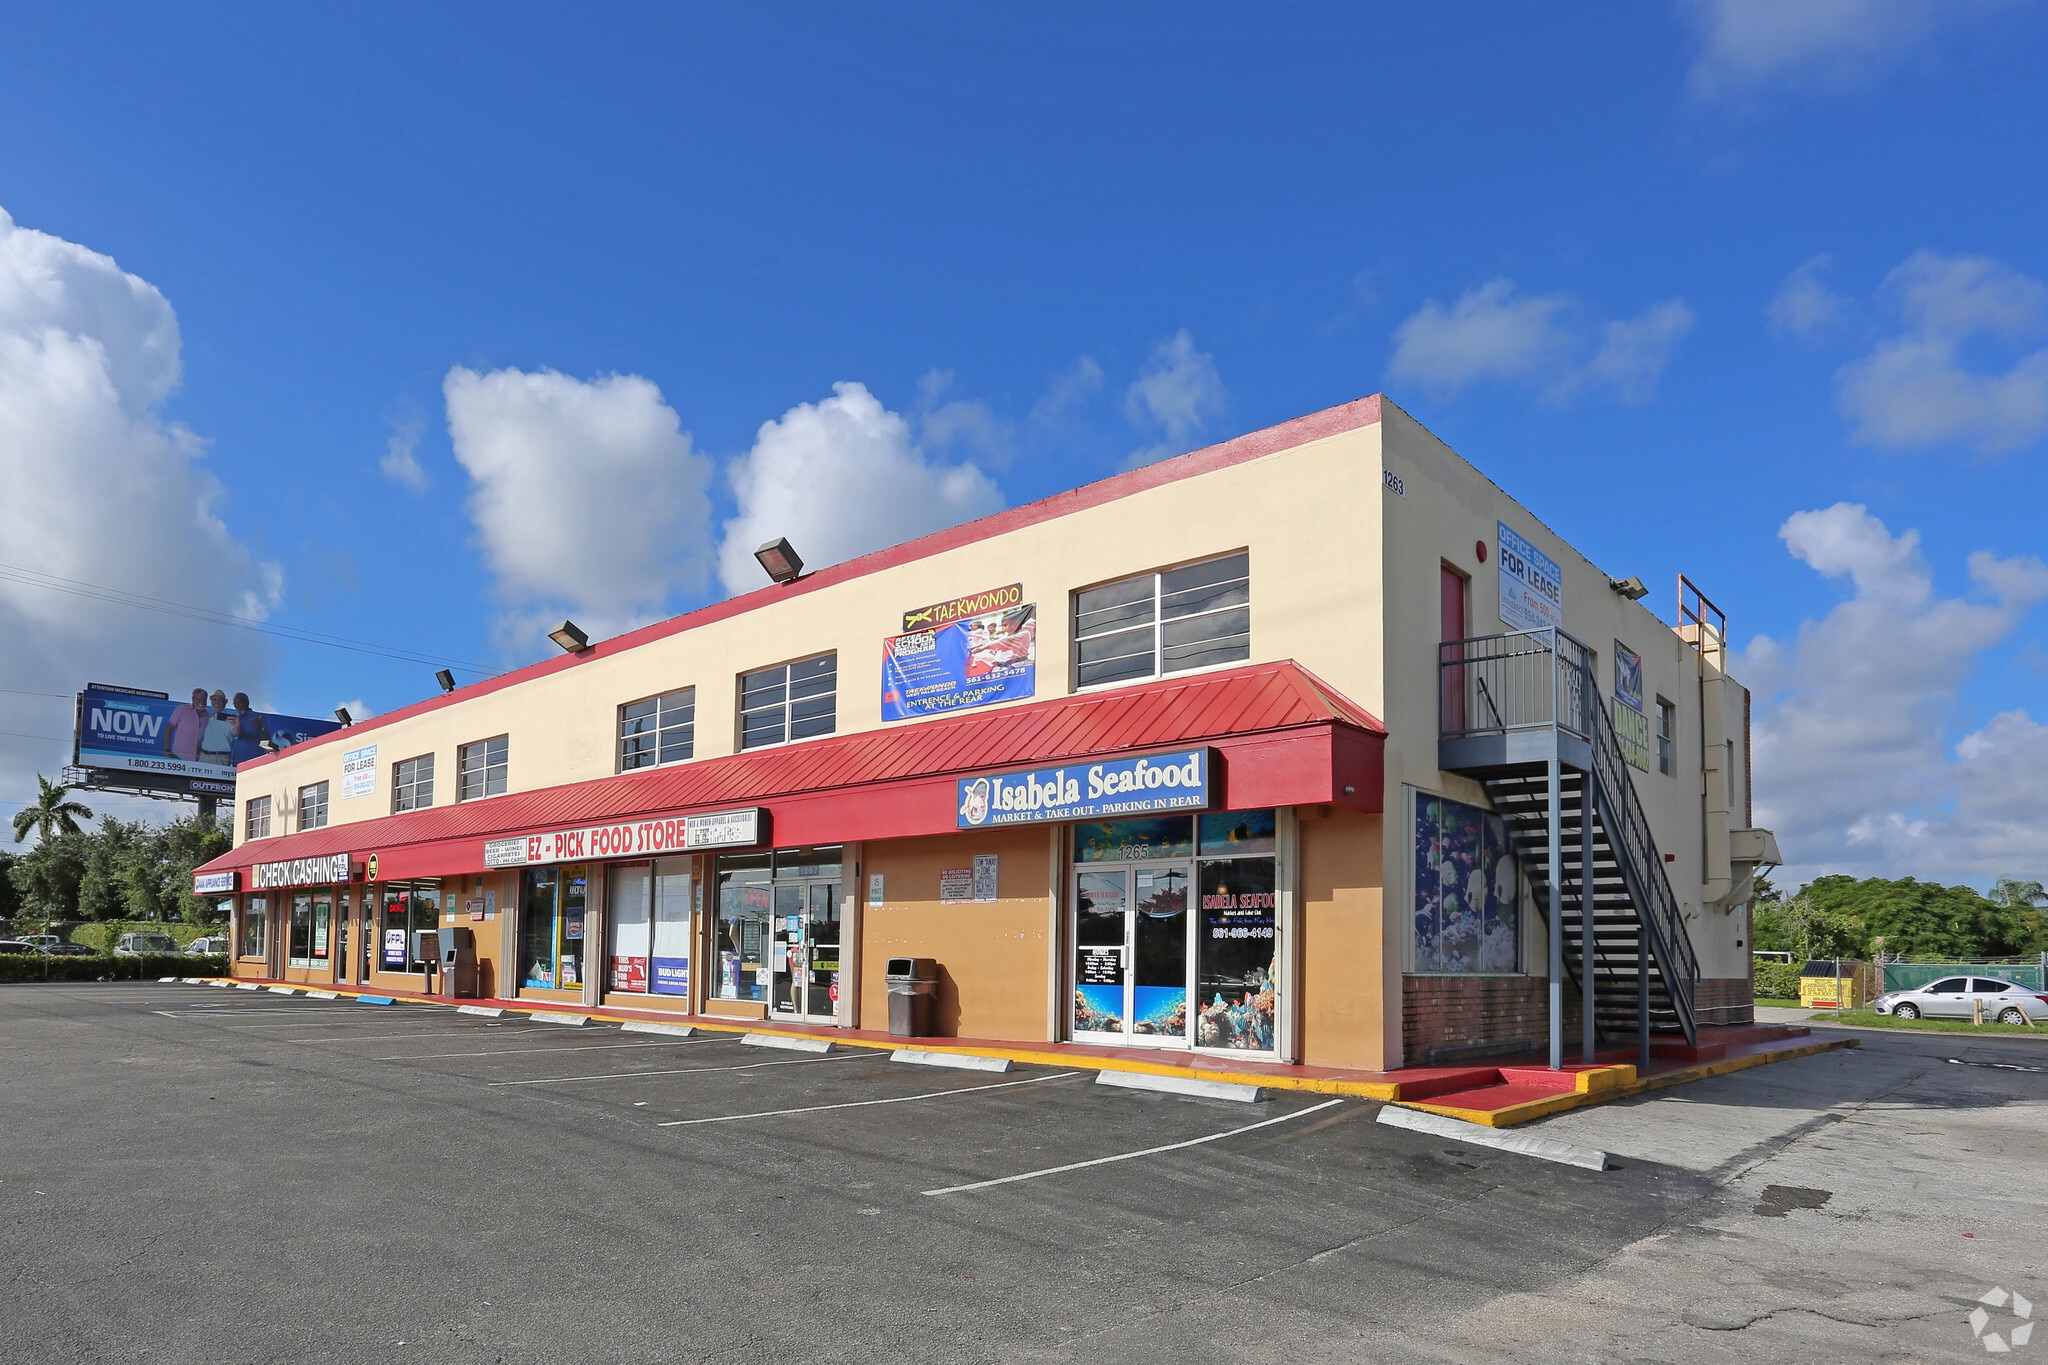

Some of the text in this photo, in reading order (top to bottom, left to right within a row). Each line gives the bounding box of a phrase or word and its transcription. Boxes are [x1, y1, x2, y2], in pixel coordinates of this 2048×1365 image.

[1383, 469, 1404, 495] 1263
[1499, 525, 1560, 582] OFFICE SPACE
[1501, 547, 1524, 580] FOR
[1527, 565, 1560, 605] LEASE
[933, 587, 1020, 622] TAEKWONDO
[1523, 591, 1539, 611] From
[1539, 601, 1550, 618] 500
[895, 635, 936, 649] SCHOOL
[894, 645, 936, 658] PROGRAM
[966, 667, 1026, 684] 561-632-5478
[905, 681, 957, 695] TAEKWONDO
[906, 694, 951, 708] ENTRENCE
[962, 684, 1005, 697] PARKING
[935, 686, 956, 694] BEACH
[924, 695, 983, 710] AT THE REAR
[90, 707, 164, 737] NOW
[1613, 700, 1648, 751] DANCE
[126, 736, 145, 744] SIMPLY
[344, 746, 377, 763] OFFICE SPACE
[127, 758, 186, 772] 1.800.233.5994
[344, 757, 375, 774] FOR LEASE
[992, 753, 1202, 811] Isabela Seafood
[992, 811, 1032, 824] MARKET
[1034, 811, 1042, 820] &
[1046, 808, 1070, 819] TAKE
[1072, 805, 1094, 817] OUT
[1102, 800, 1151, 813] PARKING
[1153, 798, 1167, 809] IN
[1169, 795, 1201, 807] REAR
[489, 840, 520, 848] GROCERIES
[527, 836, 541, 861] EZ
[555, 831, 585, 859] PICK
[590, 825, 633, 856] FOOD
[637, 819, 686, 850] STORE
[1118, 845, 1148, 860] 1265
[259, 861, 291, 888] CHECK
[292, 856, 338, 885] CASHING
[745, 889, 769, 908] OPEN
[1202, 893, 1238, 909] ISABELA
[1240, 892, 1276, 909] SEAFOO
[391, 933, 404, 944] FPL
[617, 964, 633, 973] BUD'S
[618, 956, 630, 964] THIS
[617, 972, 628, 981] FOR
[658, 968, 671, 977] BUD
